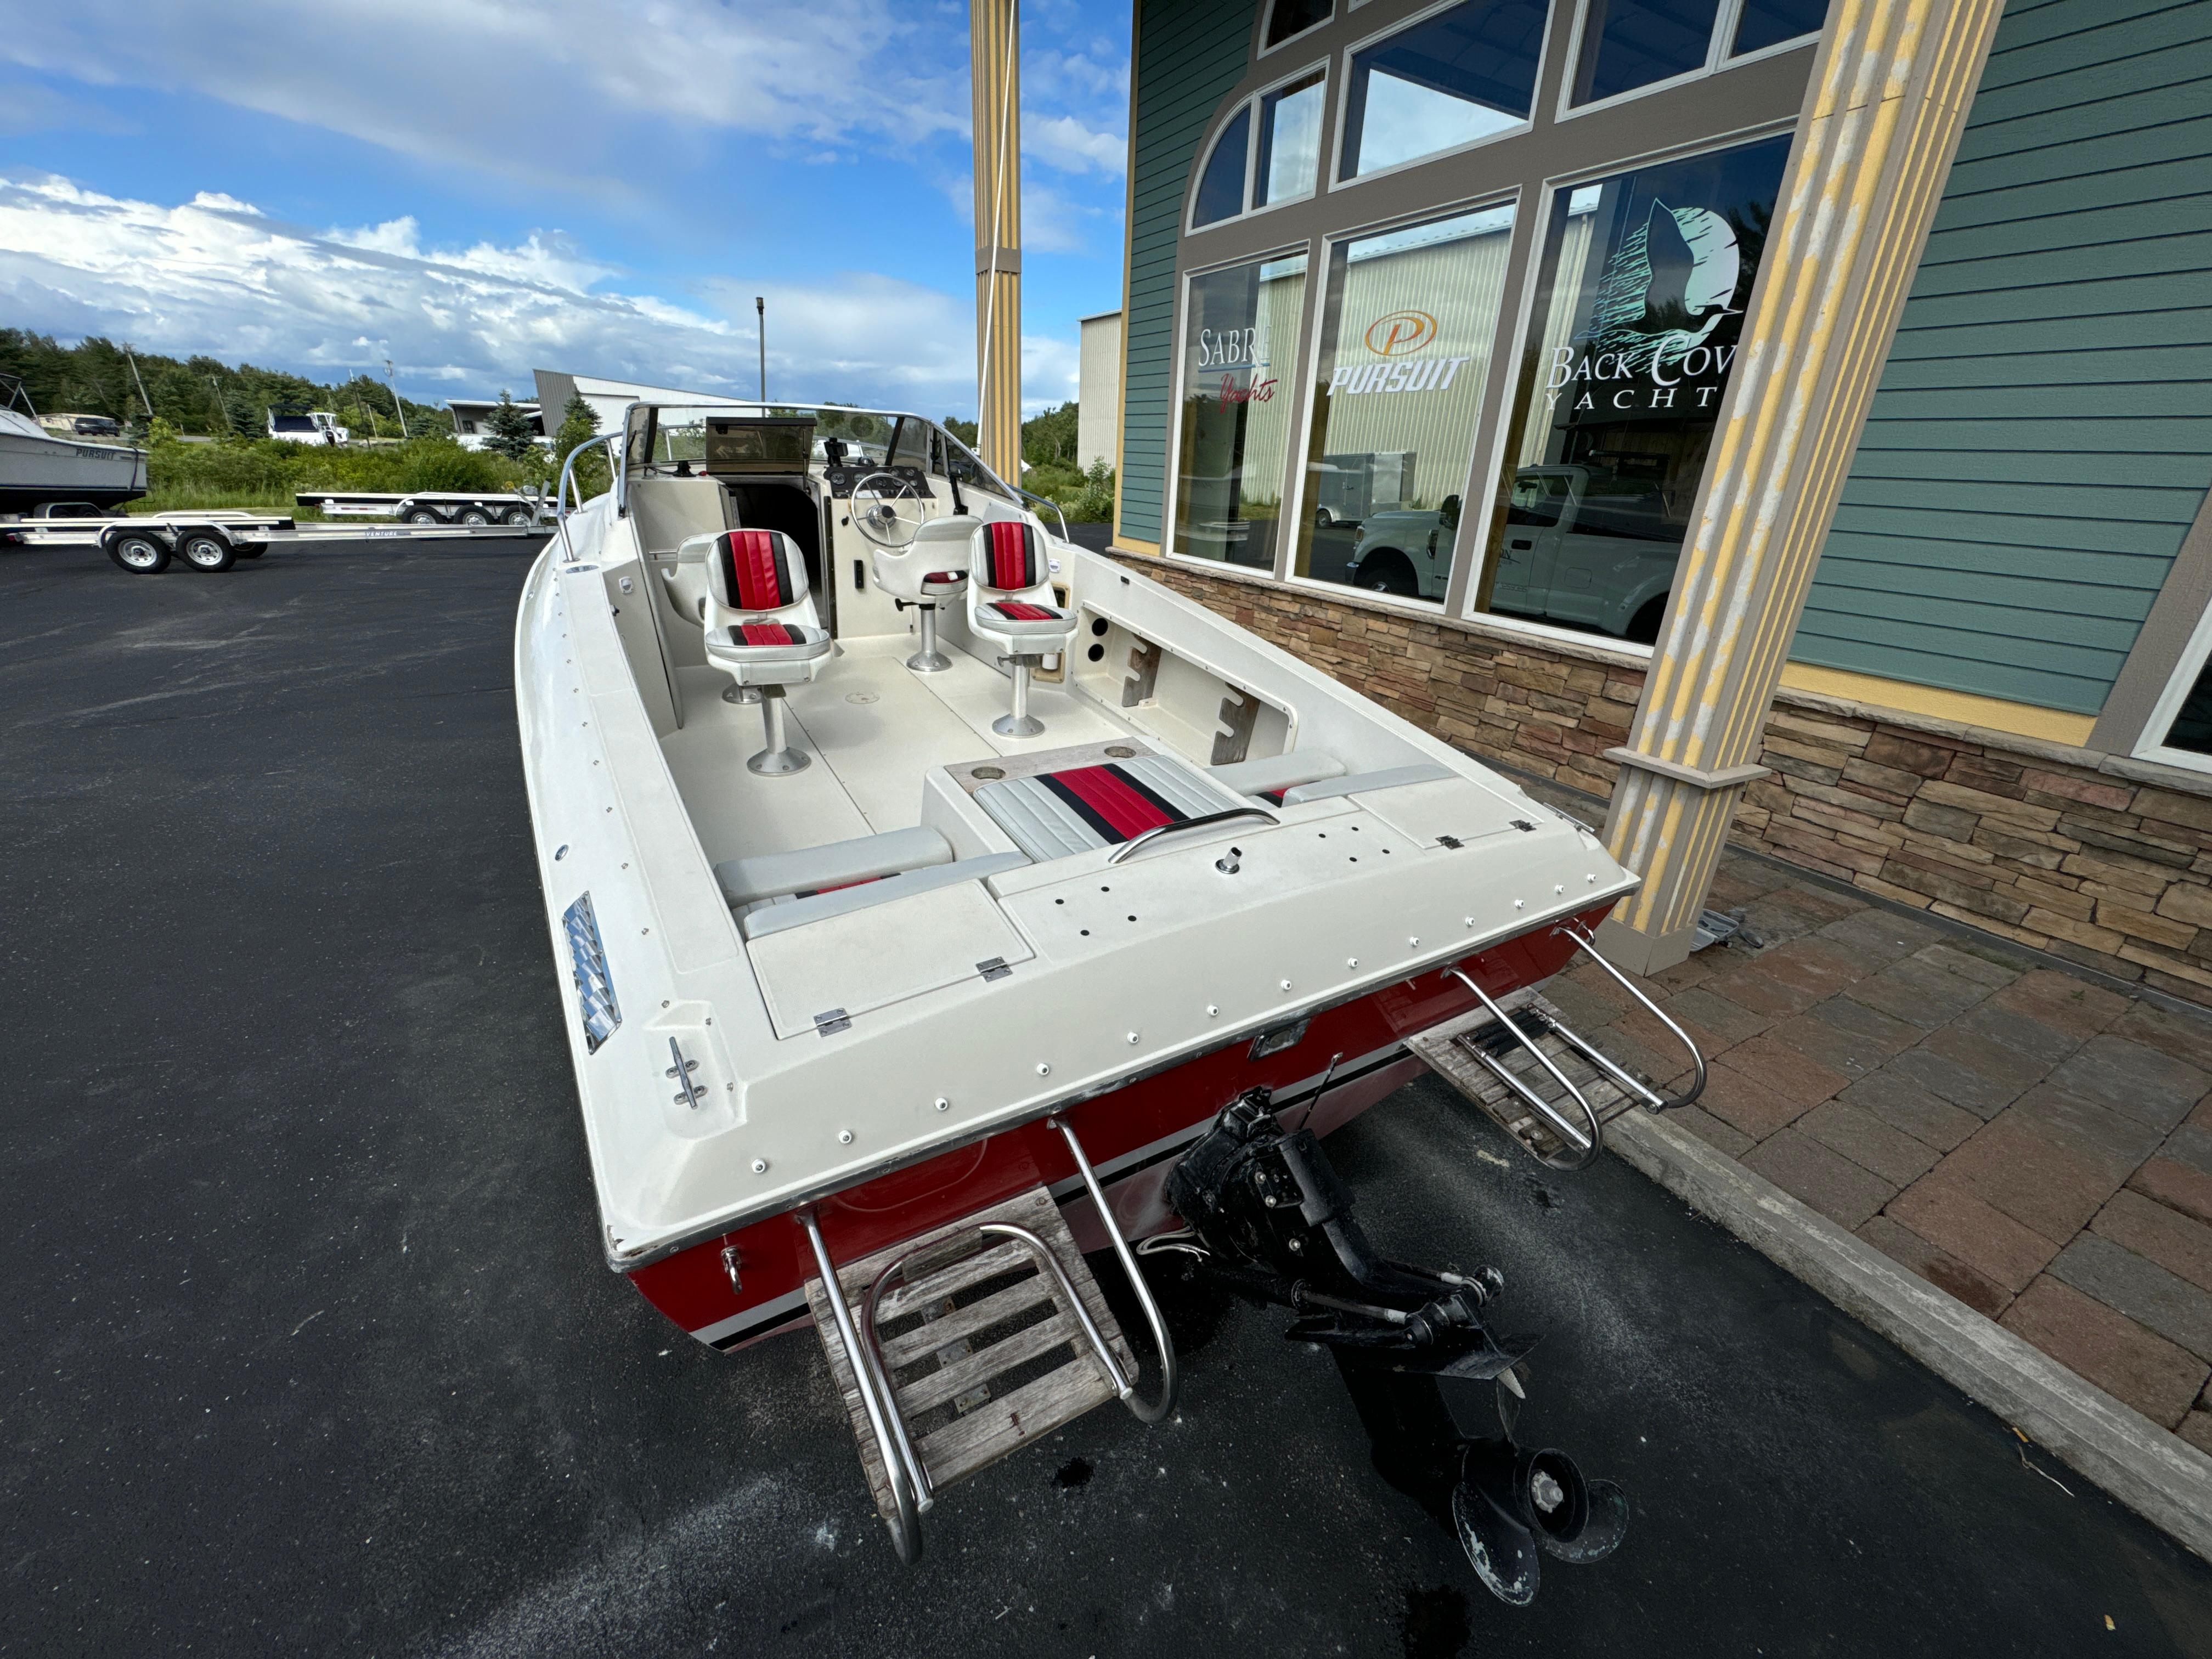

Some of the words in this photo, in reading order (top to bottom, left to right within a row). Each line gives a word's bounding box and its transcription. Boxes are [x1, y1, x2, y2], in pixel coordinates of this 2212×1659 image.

[1326, 356, 1470, 396] PURSUIT
[1545, 346, 1637, 389] BACK
[1220, 373, 1278, 413] Yachts
[1545, 386, 1718, 410] YACHT
[76, 448, 116, 461] PURSUIT
